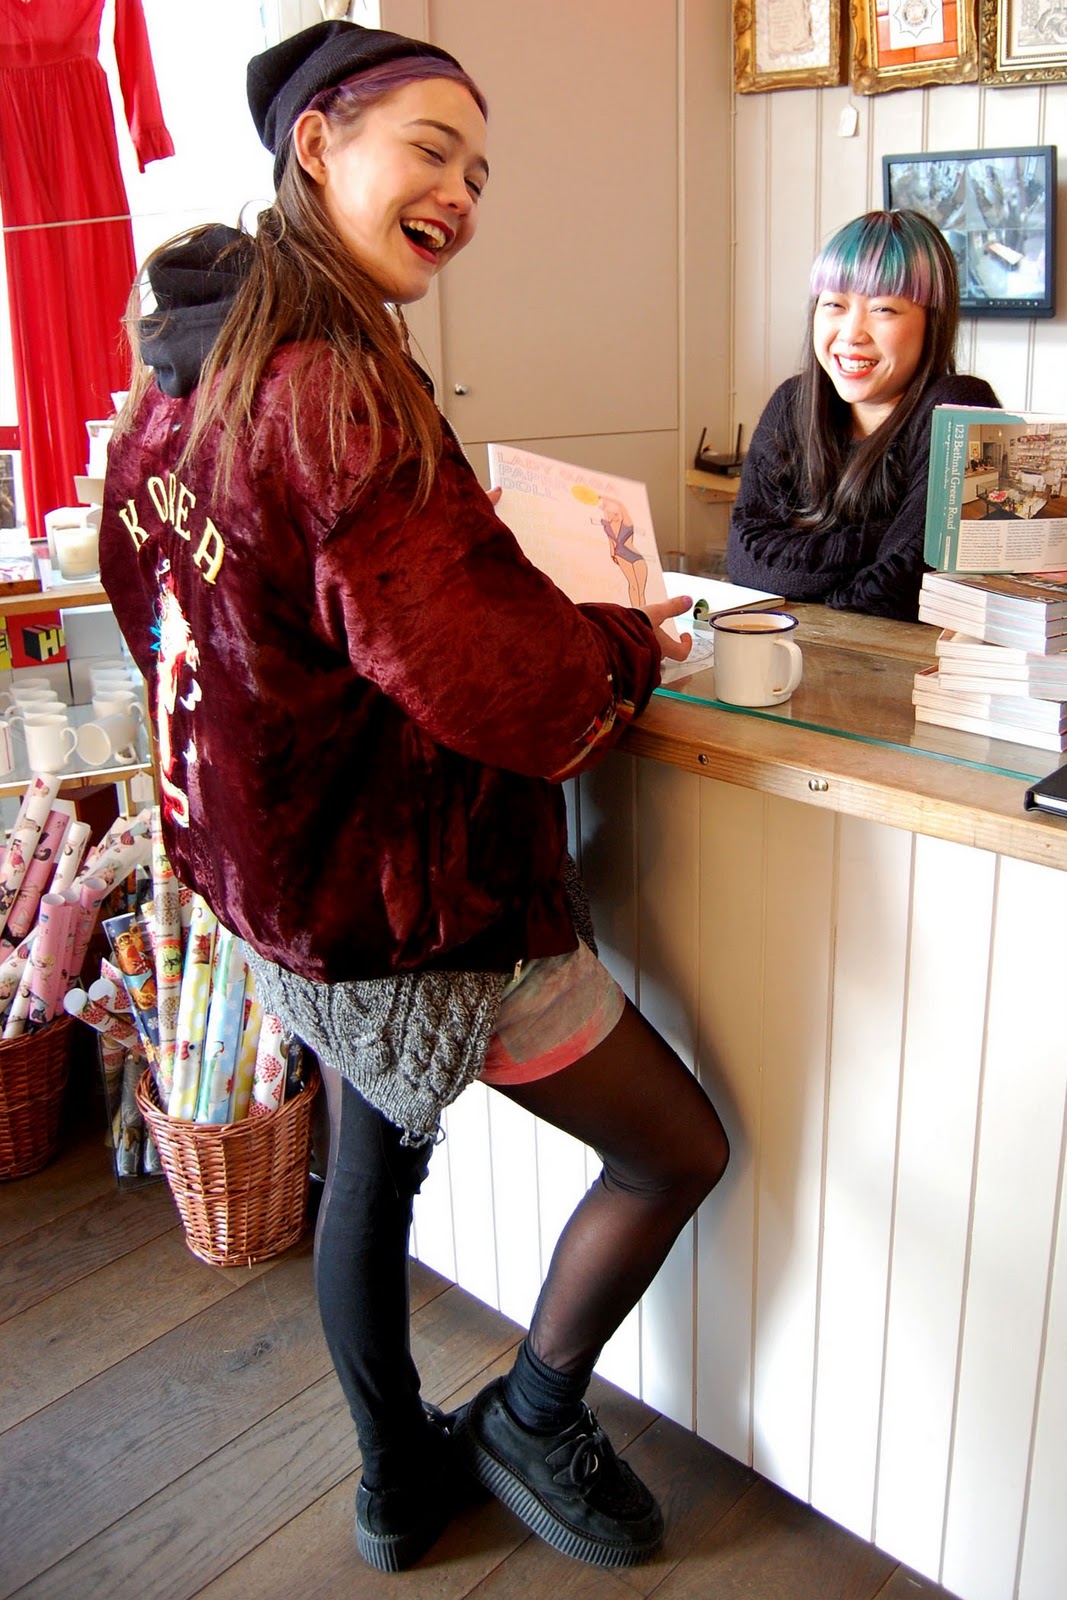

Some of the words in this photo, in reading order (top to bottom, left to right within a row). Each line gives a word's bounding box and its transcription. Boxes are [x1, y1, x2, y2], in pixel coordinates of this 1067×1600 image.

[954, 424, 964, 439] 123
[952, 440, 964, 476] Bethnal
[949, 476, 961, 505] Green
[947, 506, 958, 530] Road
